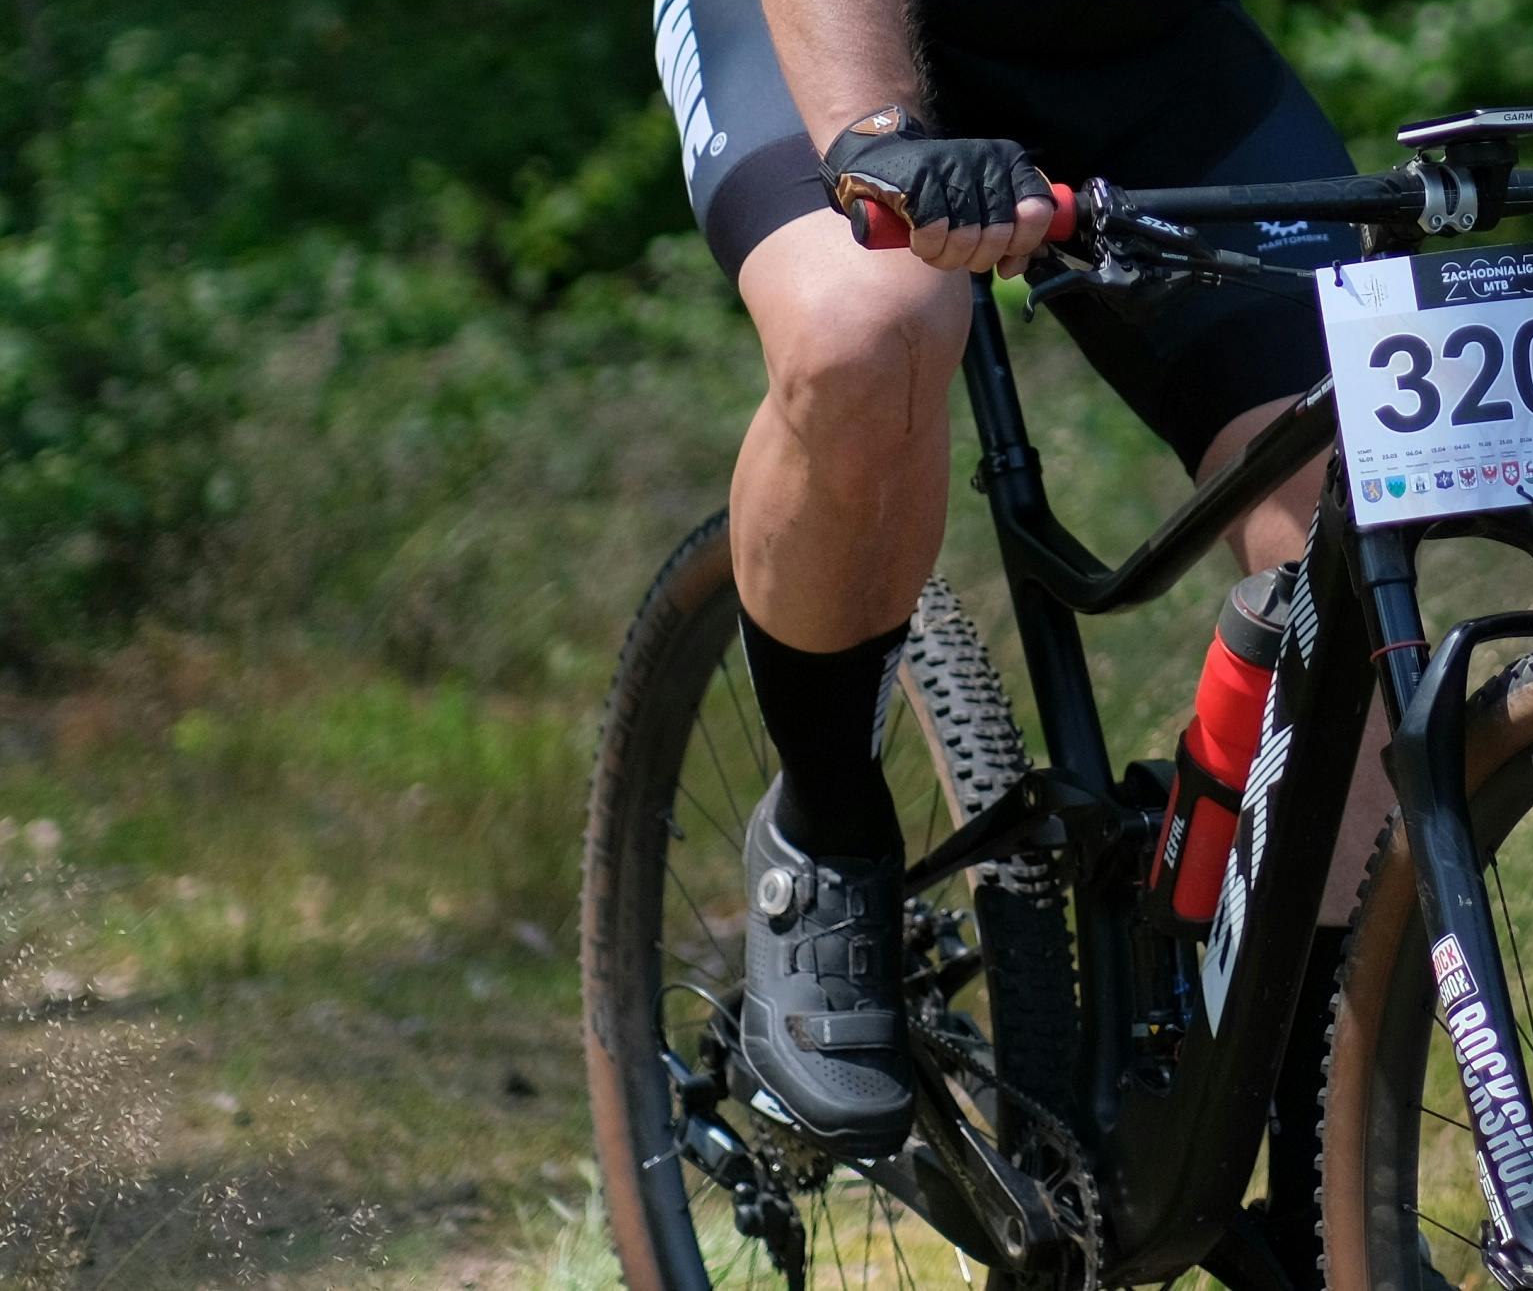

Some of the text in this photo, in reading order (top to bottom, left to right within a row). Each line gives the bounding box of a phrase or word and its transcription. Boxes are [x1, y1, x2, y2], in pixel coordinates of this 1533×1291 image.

[1441, 265, 1516, 283] ZACHODNIA
[1483, 280, 1509, 292] MTB
[1439, 968, 1472, 1008] SHOX
